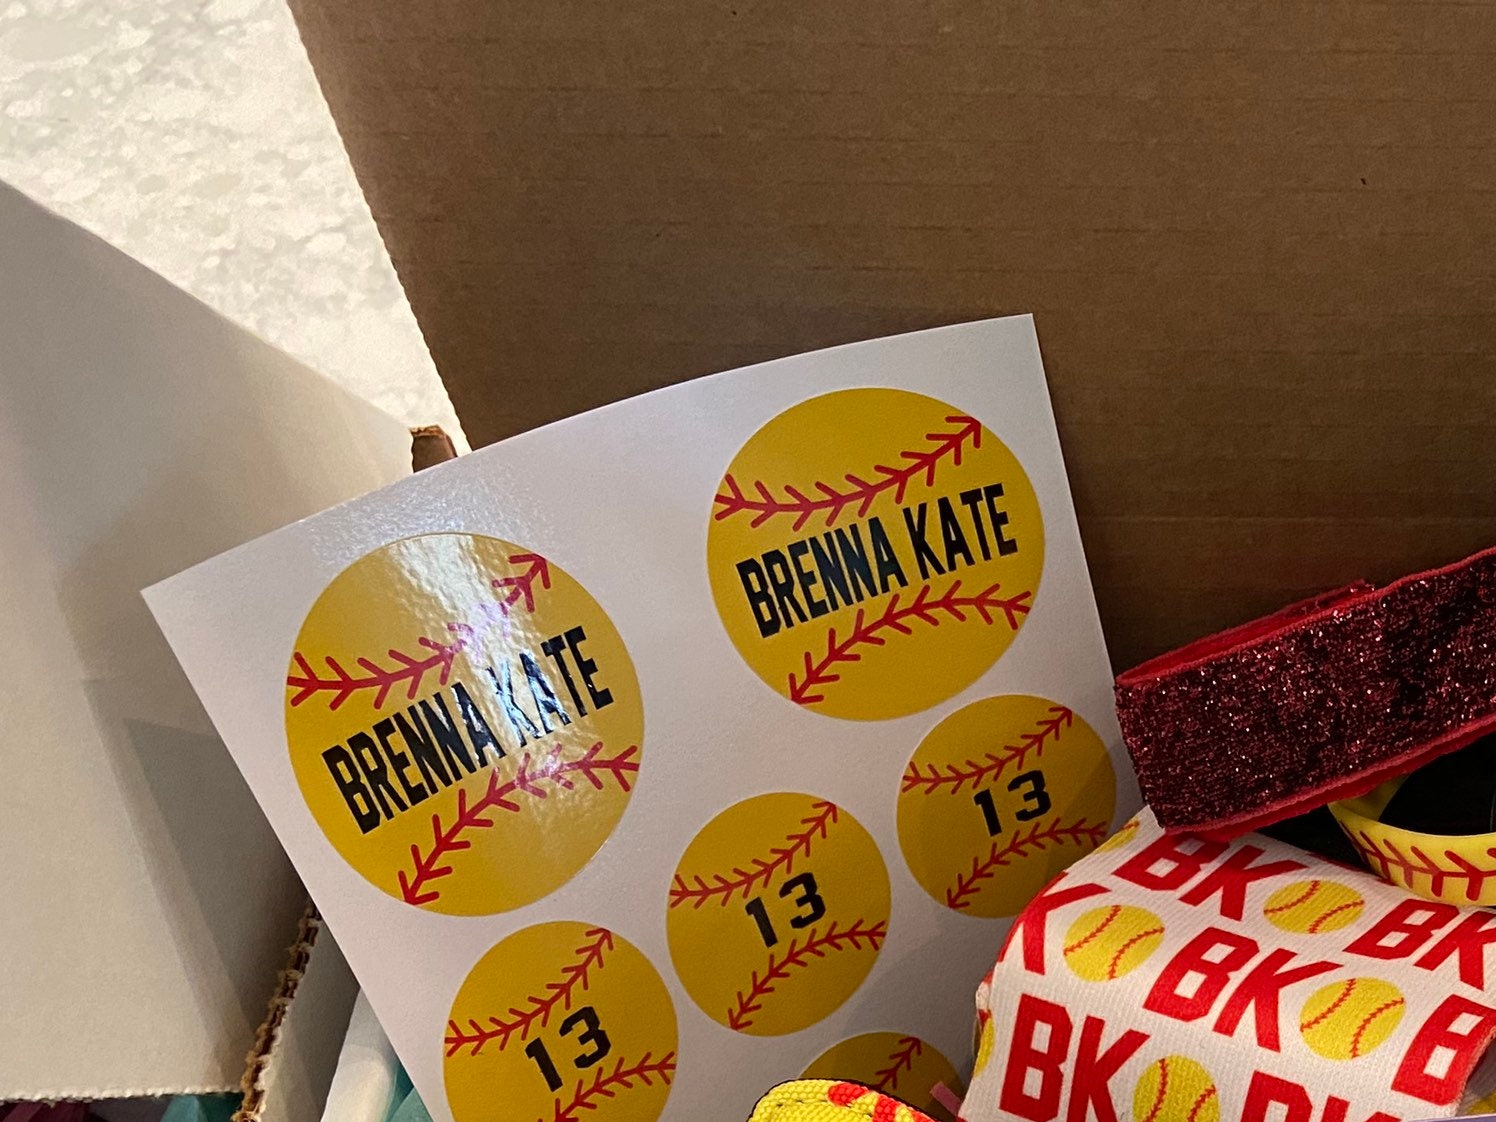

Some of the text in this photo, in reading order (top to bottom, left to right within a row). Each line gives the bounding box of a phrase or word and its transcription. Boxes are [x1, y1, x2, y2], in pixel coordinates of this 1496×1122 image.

[737, 483, 1017, 638] BRENNA KATE
[323, 626, 614, 834] BRENNA KATE
[972, 770, 1052, 838] 13
[745, 872, 827, 948] 13
[1112, 832, 1310, 921] BK
[1143, 926, 1341, 1054] BK
[525, 1006, 611, 1092] 13
